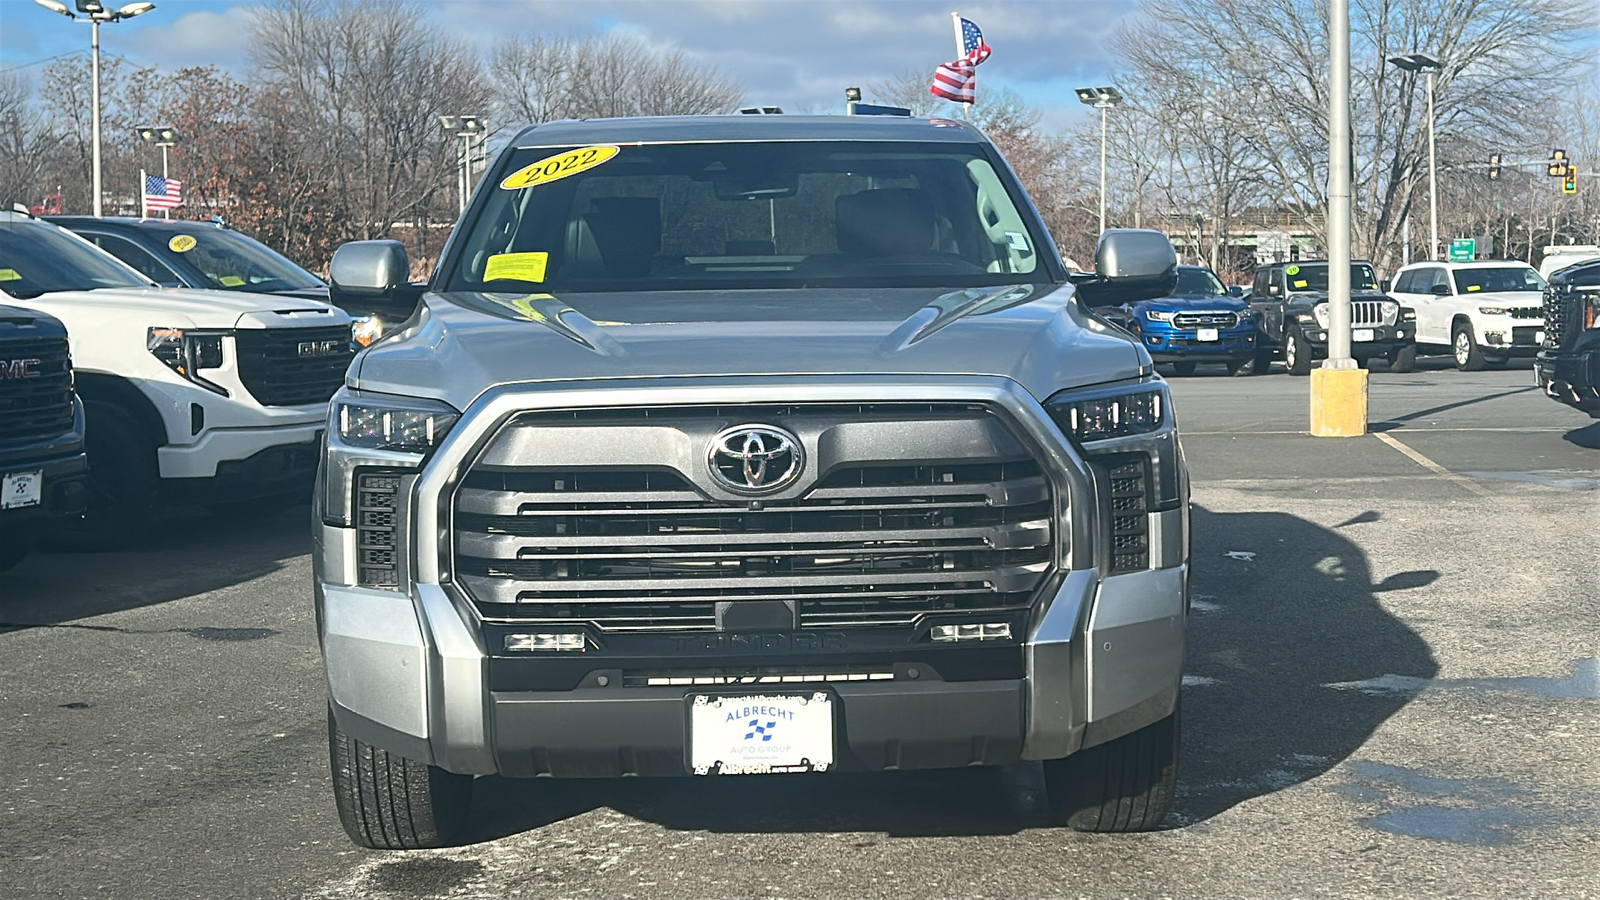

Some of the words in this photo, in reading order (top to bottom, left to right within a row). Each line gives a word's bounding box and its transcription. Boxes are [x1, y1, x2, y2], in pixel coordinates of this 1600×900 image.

[523, 149, 598, 184] 2022
[297, 340, 339, 358] GMC
[0, 358, 41, 380] MC
[725, 705, 796, 723] ALBRECHT
[730, 745, 756, 754] AUTO
[757, 745, 792, 754] GROUP
[718, 761, 772, 775] Albrecht
